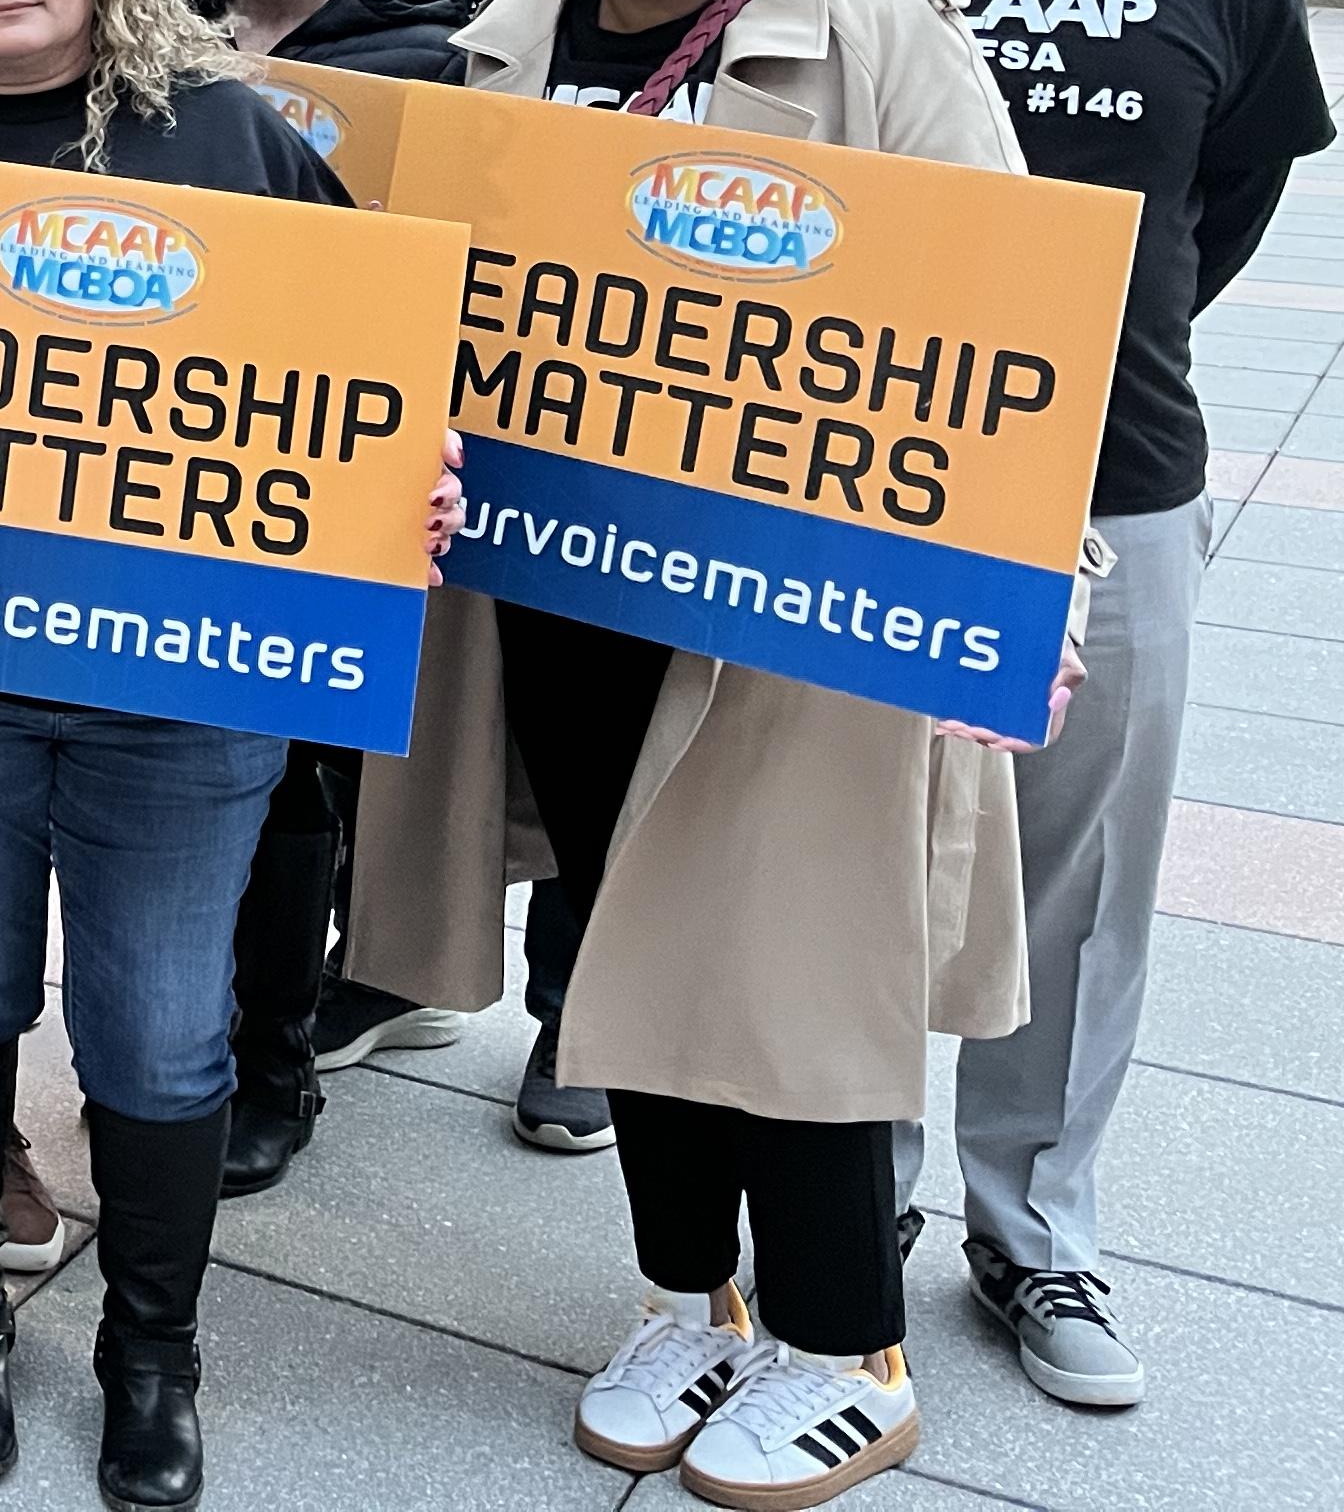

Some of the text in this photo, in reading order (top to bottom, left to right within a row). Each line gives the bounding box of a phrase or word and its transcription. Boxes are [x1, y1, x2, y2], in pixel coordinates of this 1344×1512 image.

[975, 37, 1066, 72] FSA
[1026, 82, 1144, 121] #146
[633, 194, 834, 238] LEADING AND LEARNING
[651, 163, 825, 222] MCAAP
[0, 242, 196, 279] LEADING AND LEARNING
[16, 209, 187, 264] MCAAP
[644, 207, 810, 270] MCBOA
[12, 255, 175, 313] MCBOA
[459, 247, 1056, 437] EADERSHIP
[449, 340, 952, 528] MATTERS
[459, 496, 1002, 673] urvoicematters
